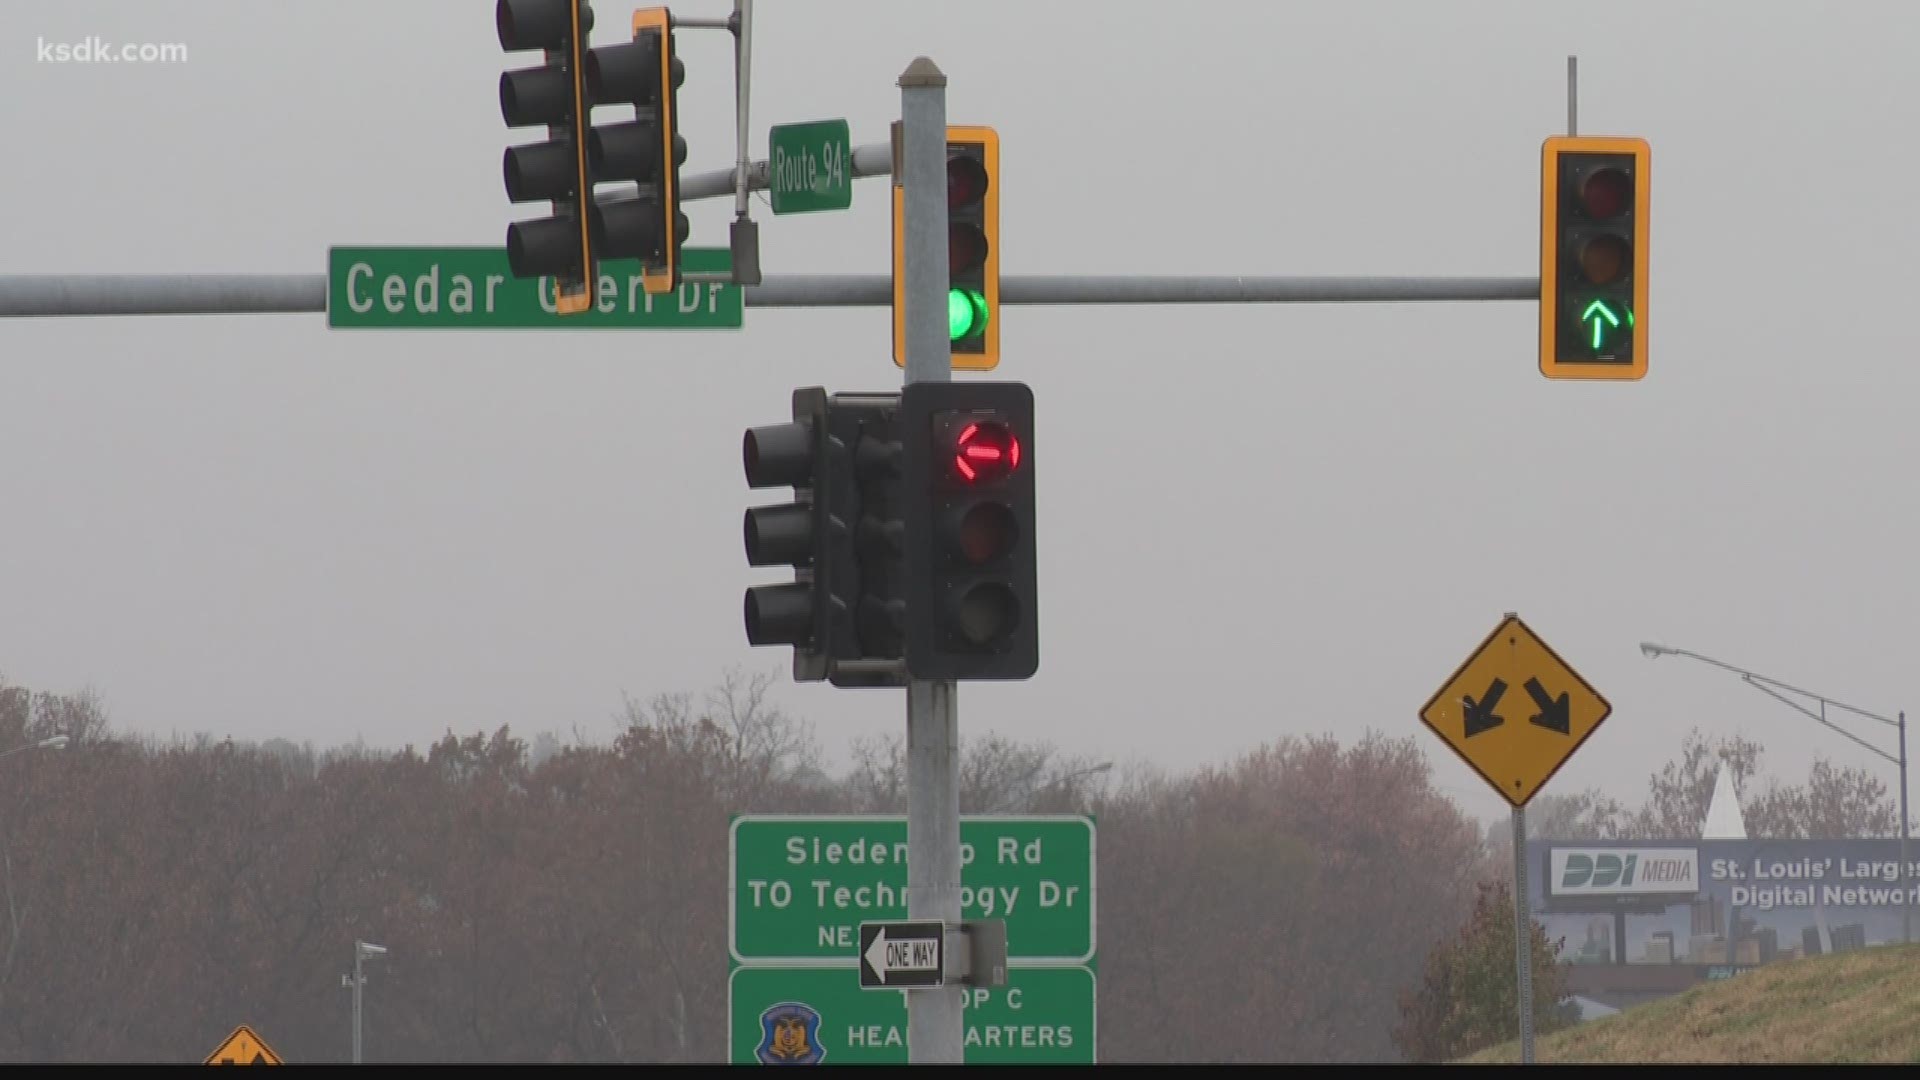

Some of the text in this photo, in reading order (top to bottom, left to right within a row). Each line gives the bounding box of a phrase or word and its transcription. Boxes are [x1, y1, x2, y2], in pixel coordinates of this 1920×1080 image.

[776, 140, 843, 192] Route 94
[346, 262, 505, 313] Cedar
[679, 281, 724, 313] Dr
[786, 837, 1042, 869] Siedenp Rd
[1562, 853, 1691, 887] DDI MEDIA
[1711, 858, 1746, 880] St.
[748, 880, 792, 907] TO
[1038, 882, 1080, 908] Dr
[1731, 885, 1815, 911] Digital
[886, 942, 936, 967] ONE WAY
[1007, 989, 1023, 1010] C
[848, 1026, 1073, 1047] HEAARTERS
